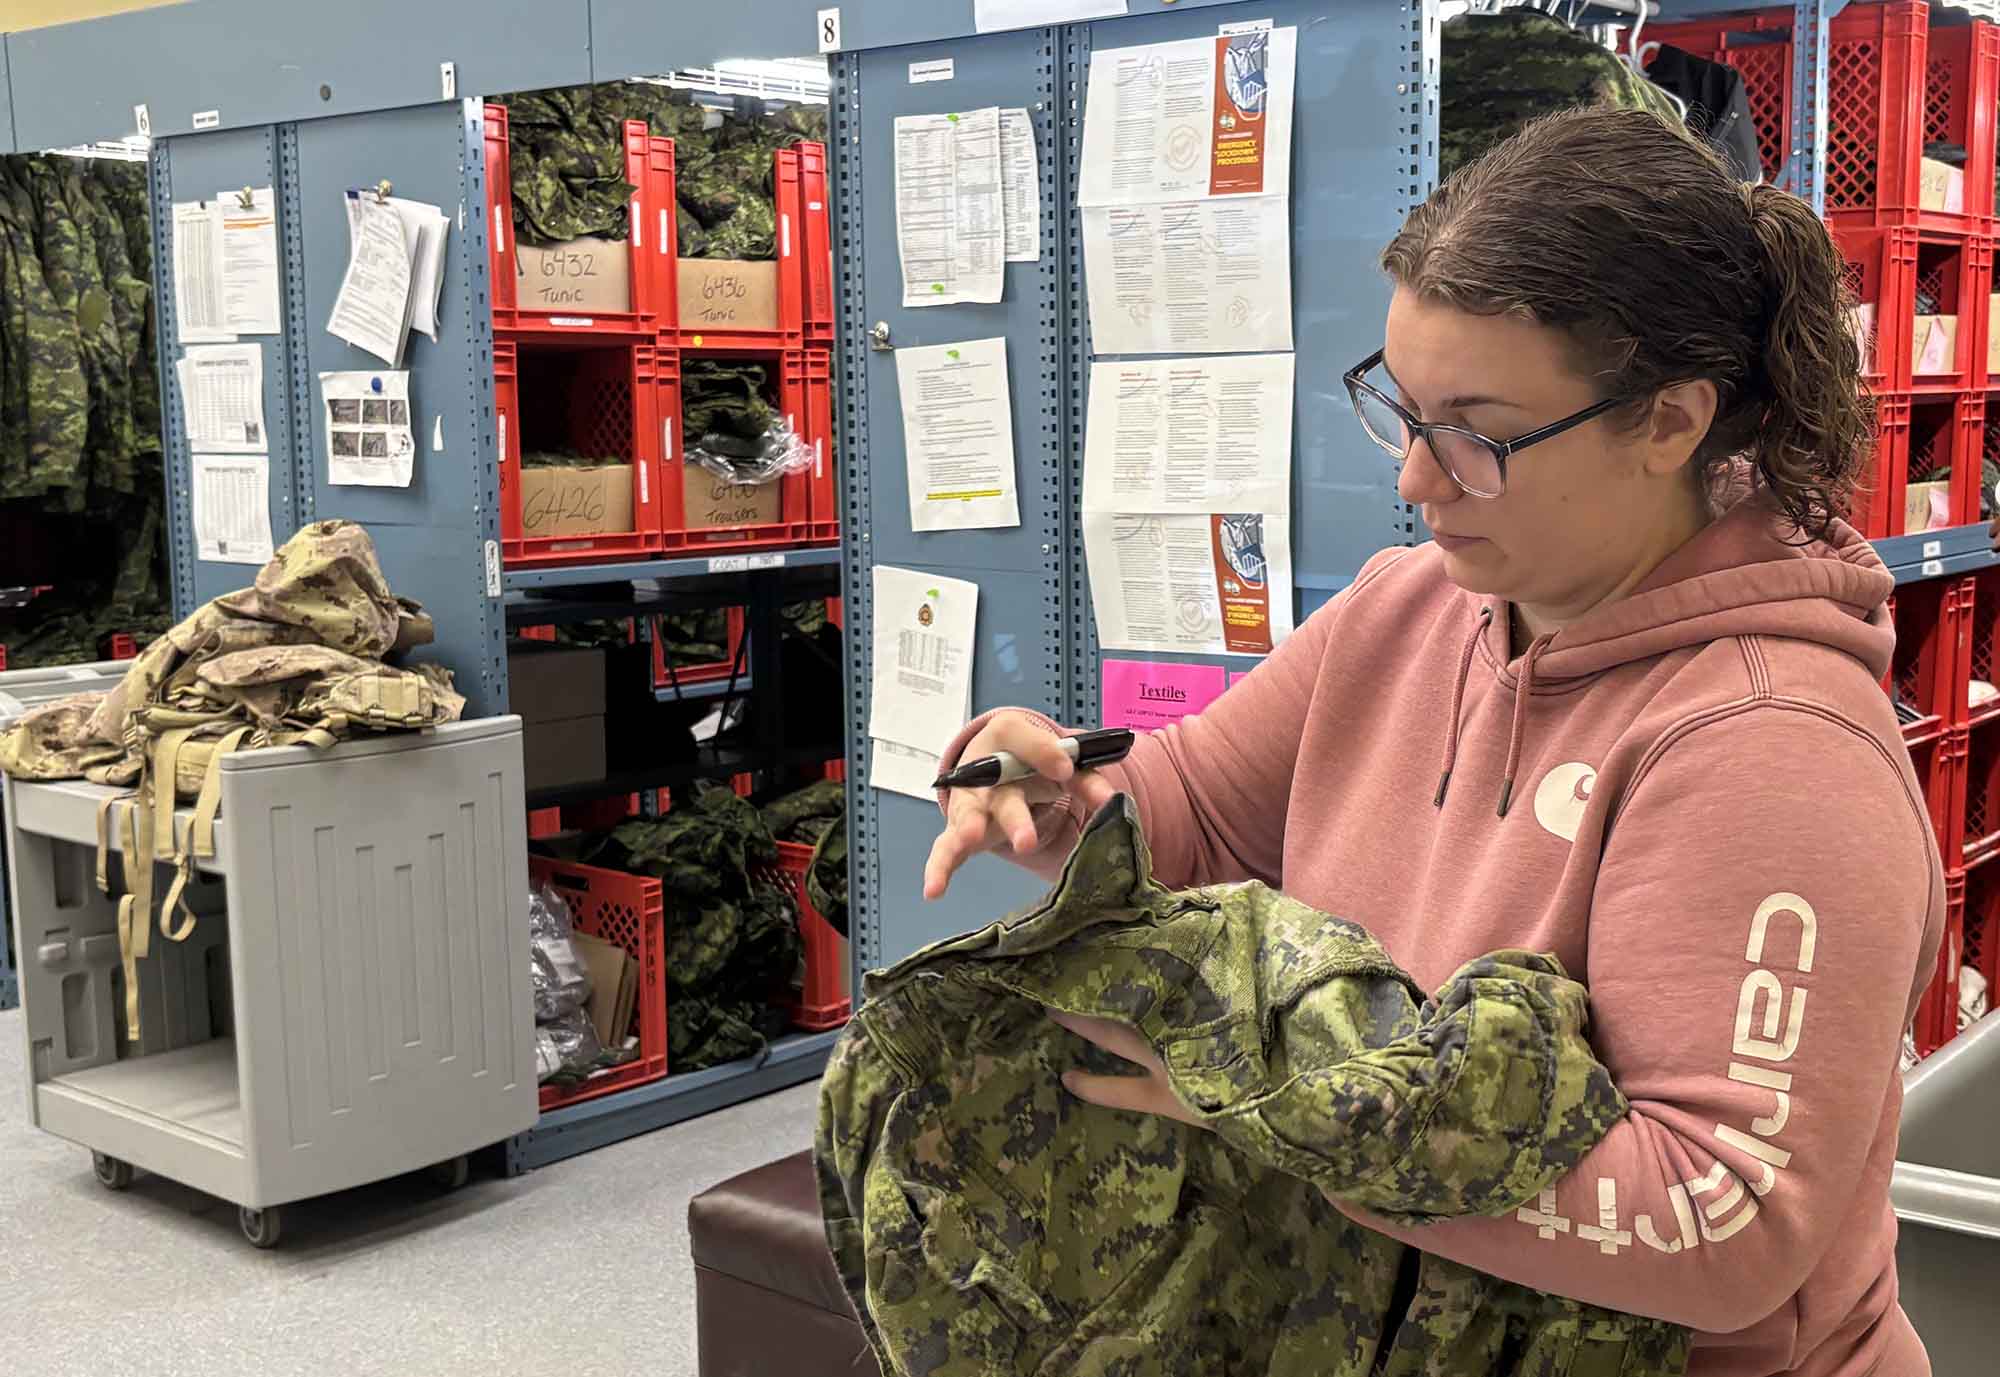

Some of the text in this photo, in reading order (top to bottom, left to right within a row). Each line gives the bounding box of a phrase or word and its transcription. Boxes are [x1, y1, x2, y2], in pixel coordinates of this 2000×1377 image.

[824, 17, 835, 43] 8
[540, 251, 598, 277] 6432
[537, 287, 585, 304] Tunic
[523, 486, 605, 529] 6426
[705, 507, 759, 524] Trousers
[1139, 683, 1187, 699] Textiles
